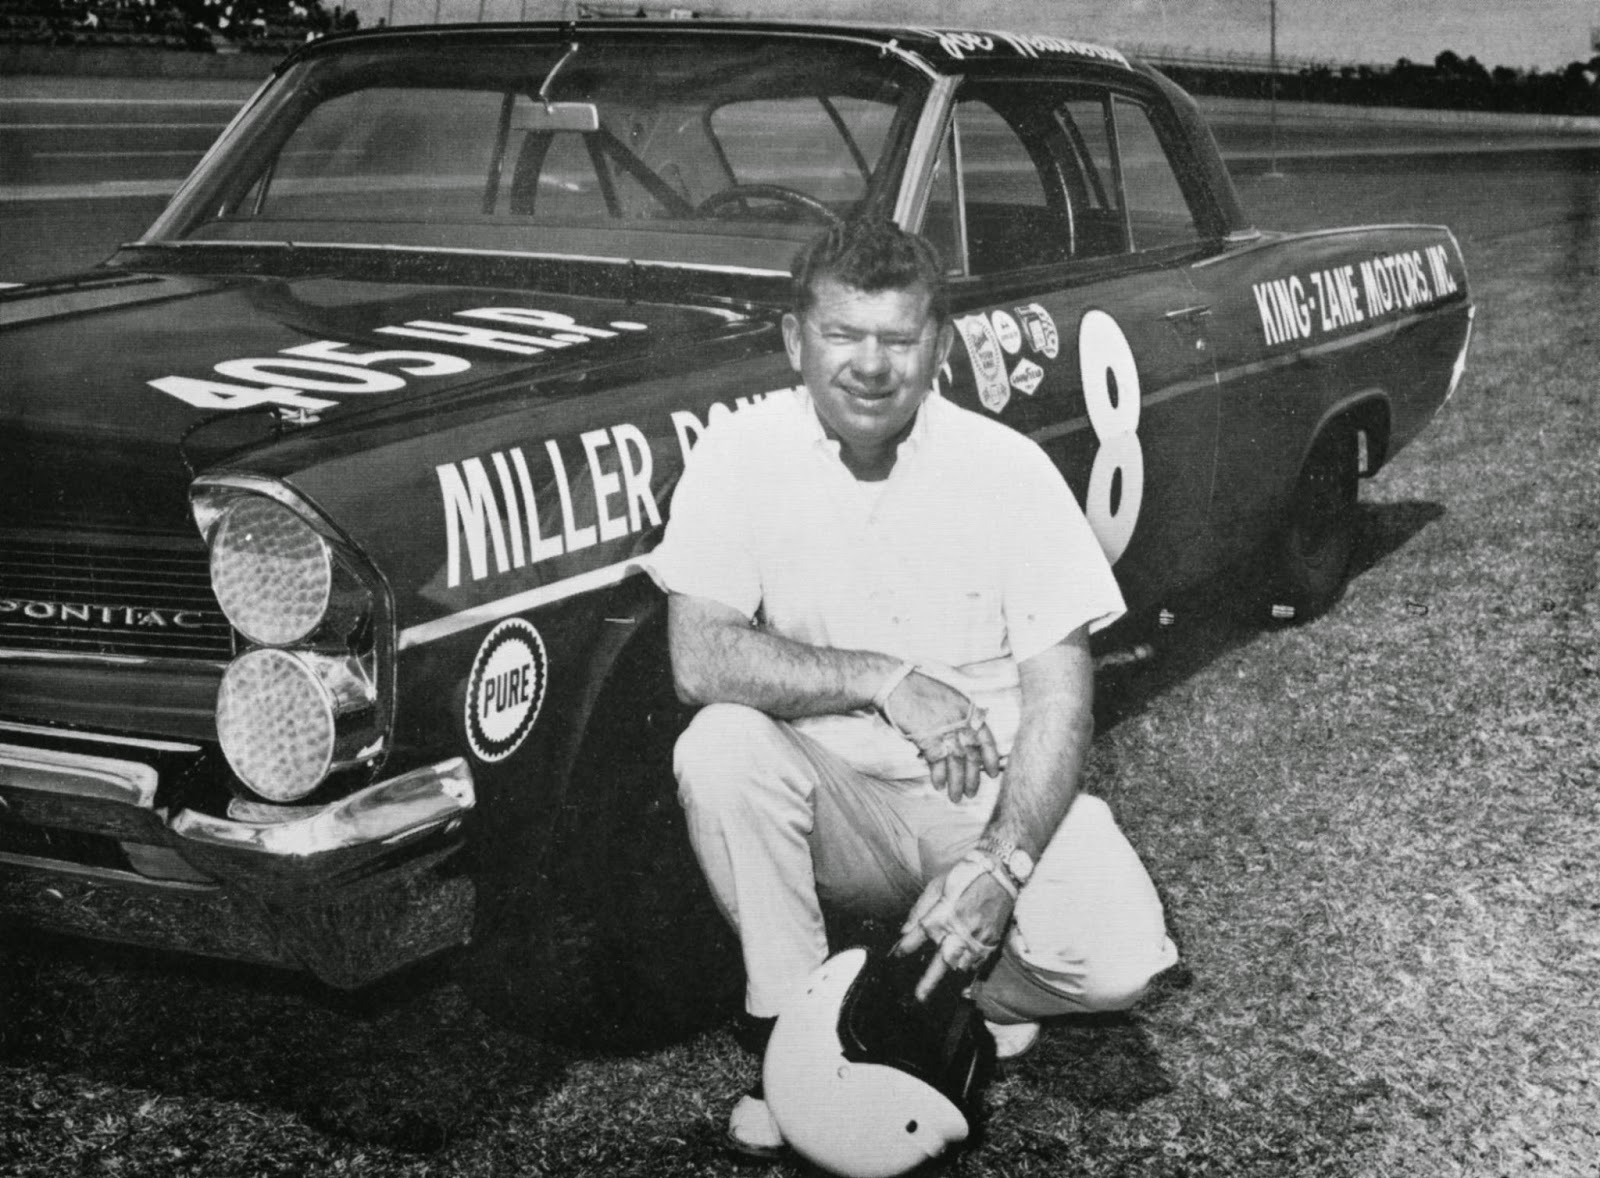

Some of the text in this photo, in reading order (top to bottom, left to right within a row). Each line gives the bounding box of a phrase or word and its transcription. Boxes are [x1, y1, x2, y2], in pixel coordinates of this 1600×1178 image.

[1253, 265, 1364, 346] KING-ZANE
[146, 307, 648, 410] 405 H.P.
[1079, 309, 1144, 566] 8
[436, 423, 662, 588] MILLER
[484, 663, 530, 718] PURE
